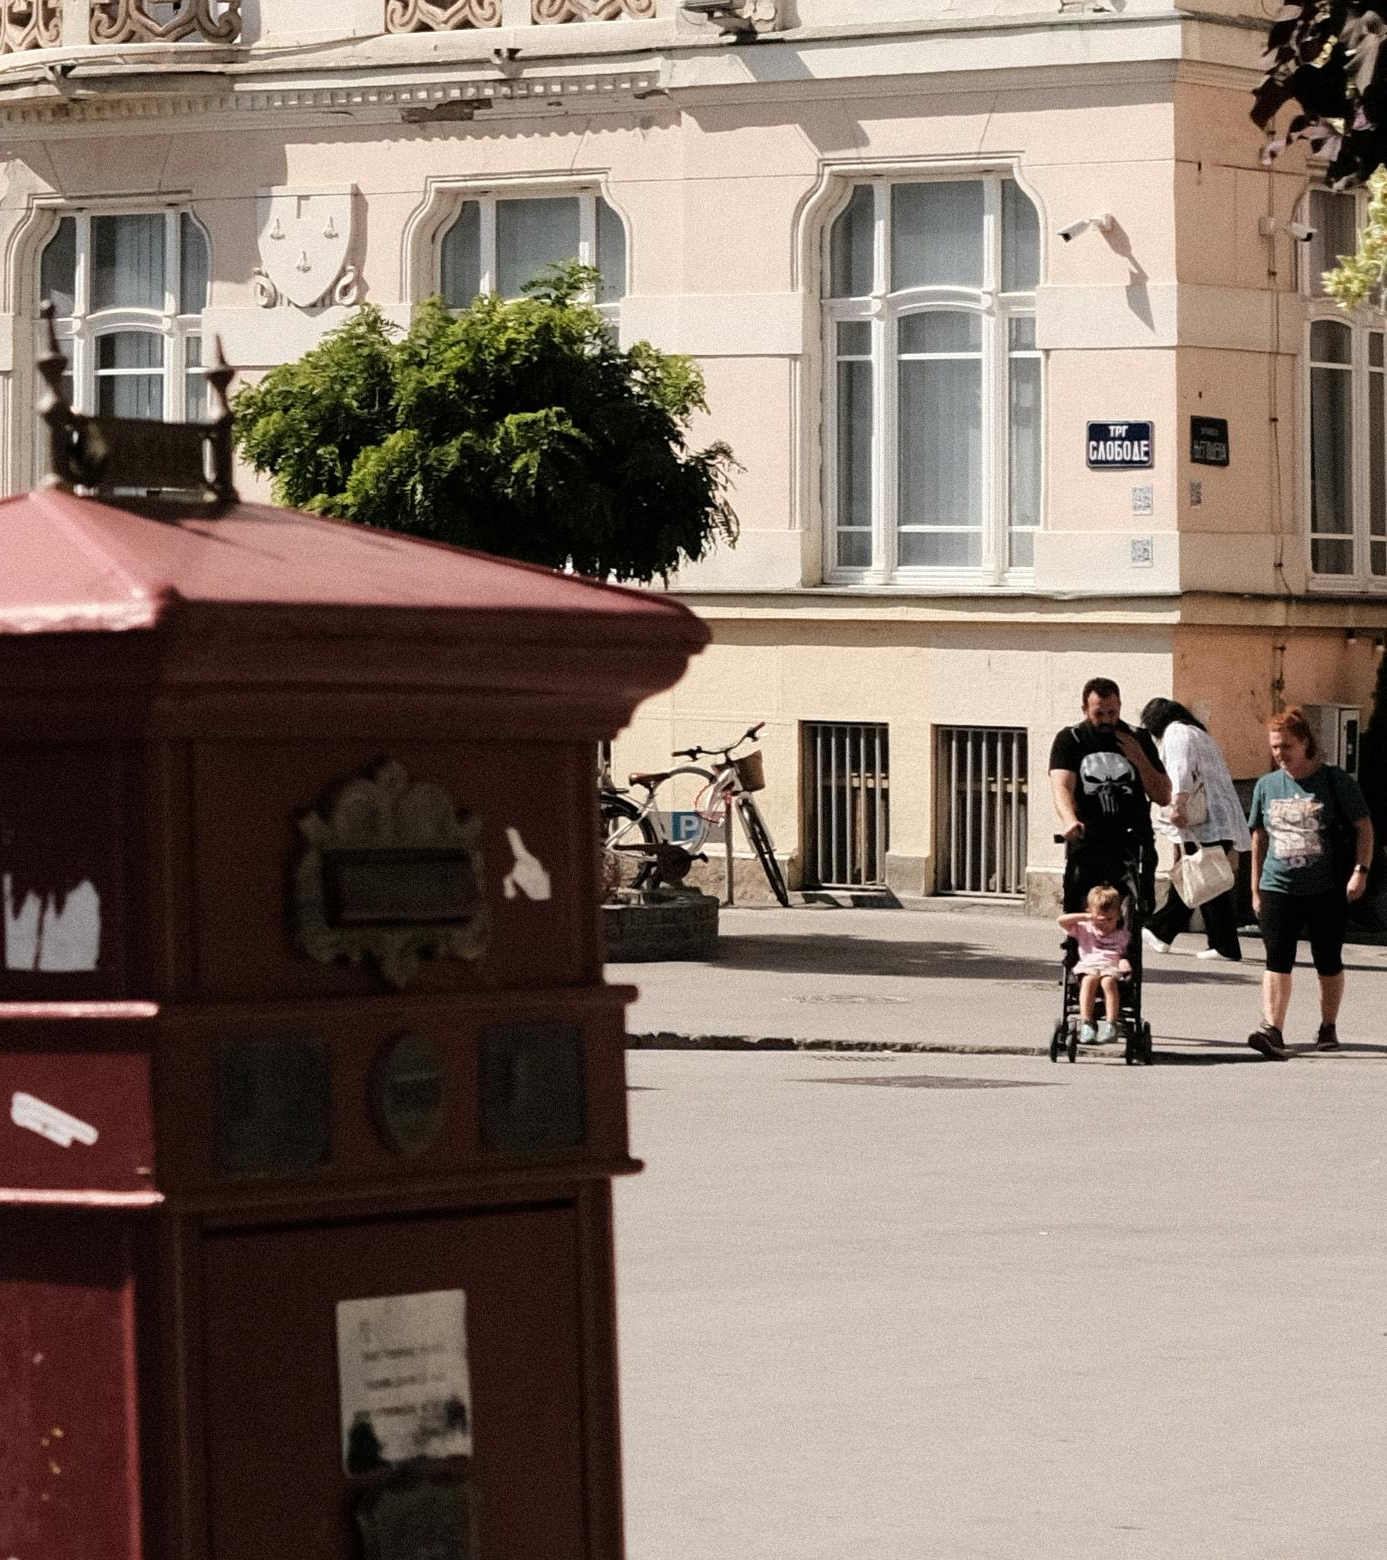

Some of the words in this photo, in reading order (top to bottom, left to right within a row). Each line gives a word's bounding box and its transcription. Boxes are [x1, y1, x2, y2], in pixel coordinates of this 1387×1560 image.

[1108, 425, 1129, 438] ТРГ
[1089, 440, 1149, 461] СЛОБОДЕ
[680, 815, 701, 838] P
